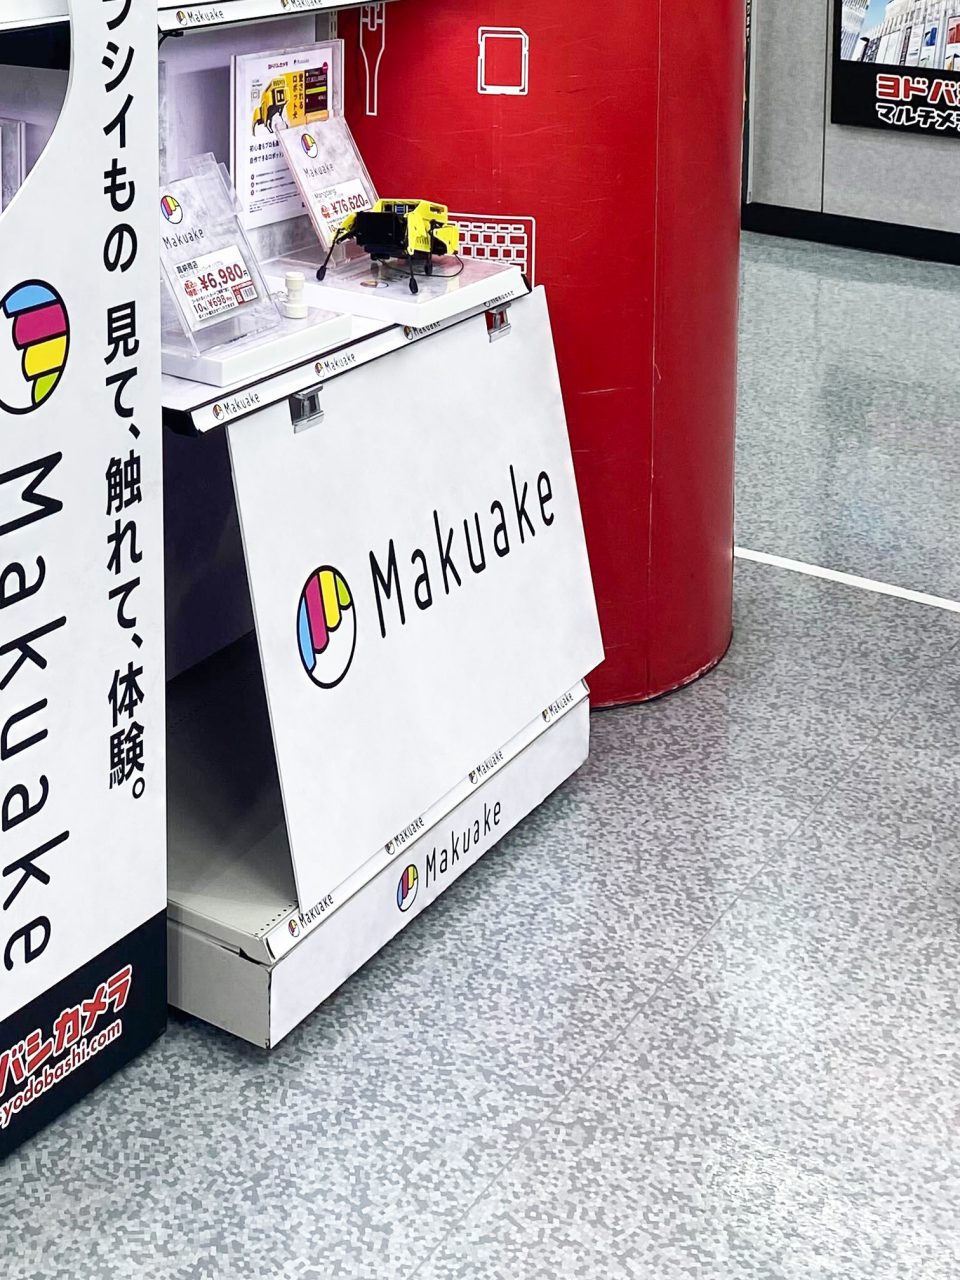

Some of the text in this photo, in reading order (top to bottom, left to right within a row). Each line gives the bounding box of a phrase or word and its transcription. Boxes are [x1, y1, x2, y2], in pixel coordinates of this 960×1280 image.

[187, 7, 225, 24] Makuake
[876, 74, 960, 107] ヨドバ
[303, 162, 334, 178] Makuake
[162, 227, 204, 250] Makuake
[323, 352, 356, 374] Makuake
[224, 391, 260, 416] Makuake
[103, 299, 147, 801] 見て、触れて、体験。
[369, 464, 556, 638] Makuake
[549, 692, 574, 719] Makuake
[476, 750, 504, 781] Makuake
[393, 815, 424, 850] Makuake
[424, 800, 502, 889] Makuake
[299, 893, 334, 928] Makuake
